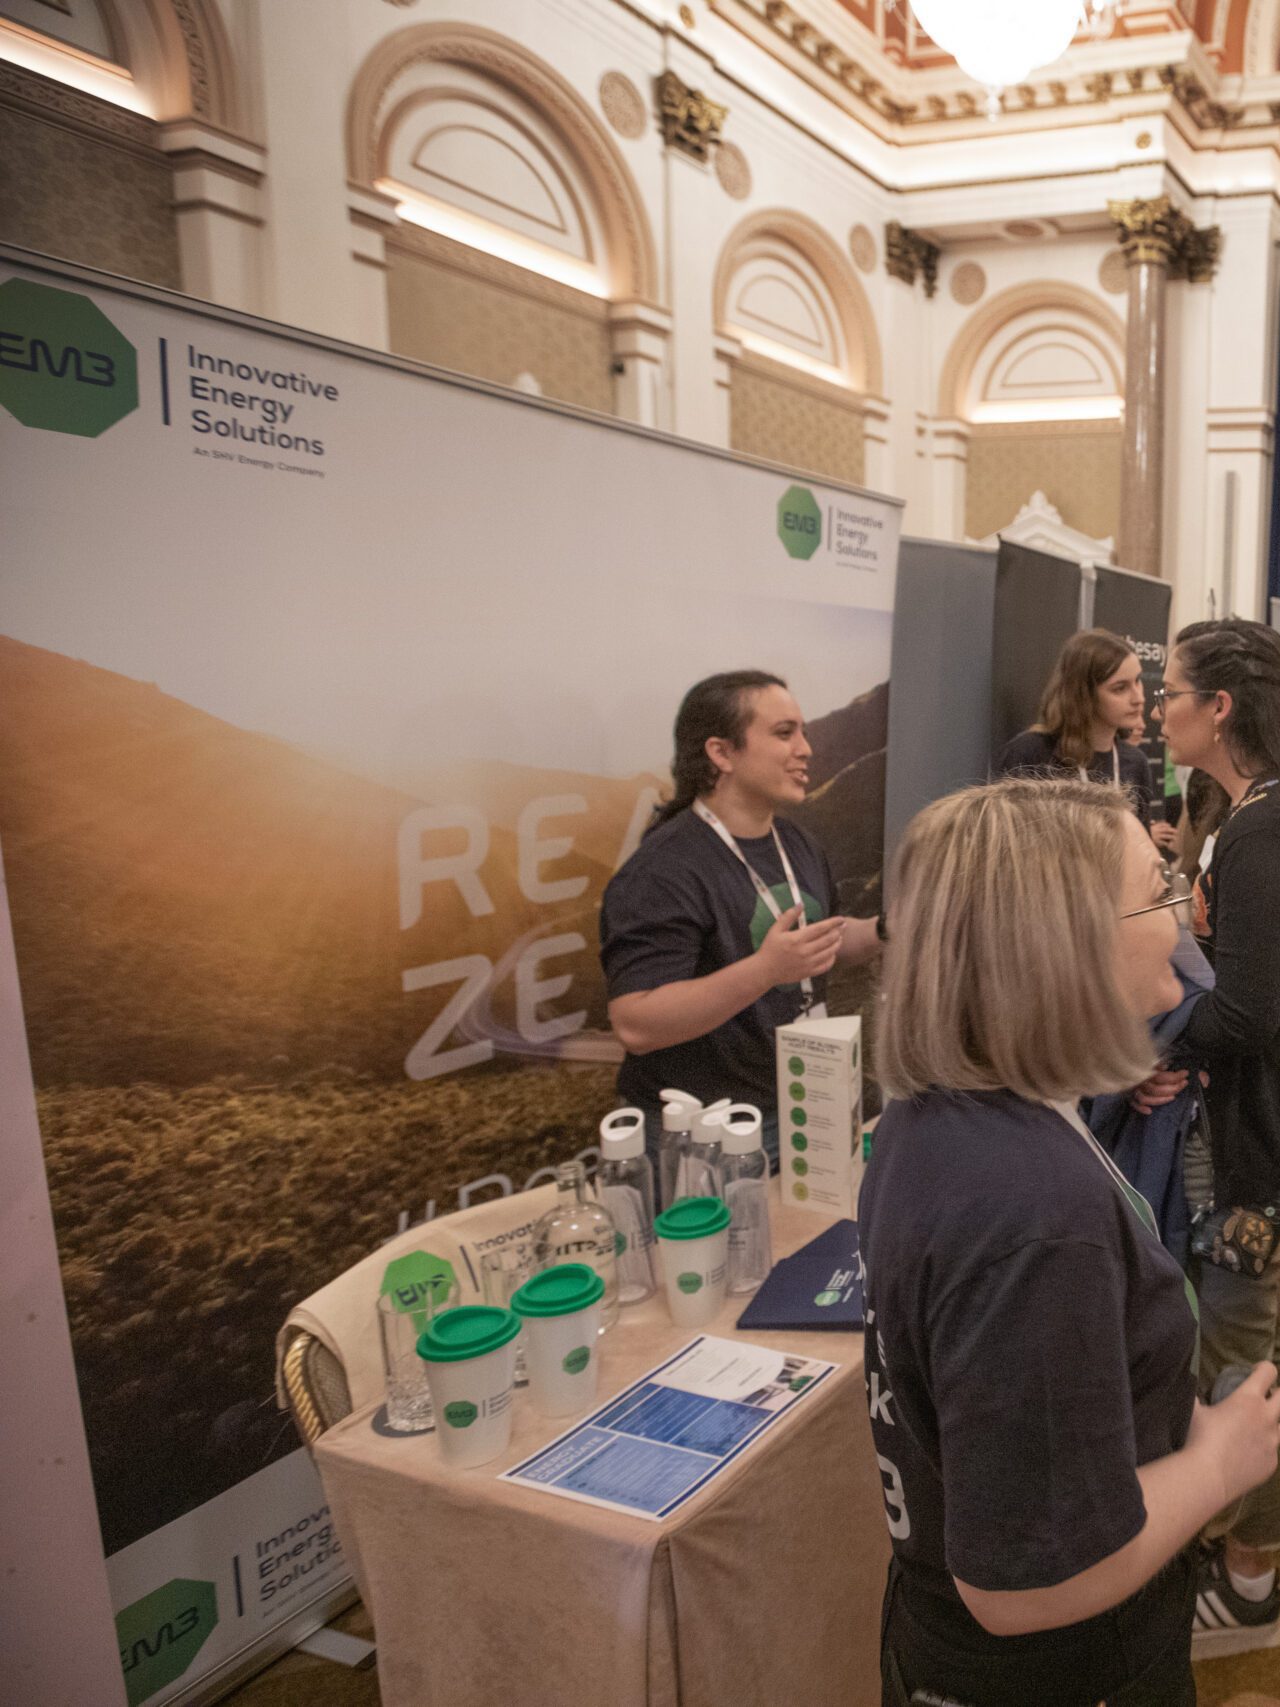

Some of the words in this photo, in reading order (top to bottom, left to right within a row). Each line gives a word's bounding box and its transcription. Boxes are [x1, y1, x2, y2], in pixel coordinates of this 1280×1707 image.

[187, 343, 340, 402] Innovative
[188, 375, 294, 424] Energy
[191, 409, 325, 457] Solutions
[836, 509, 884, 530] Innovative
[835, 541, 878, 561] Solutions
